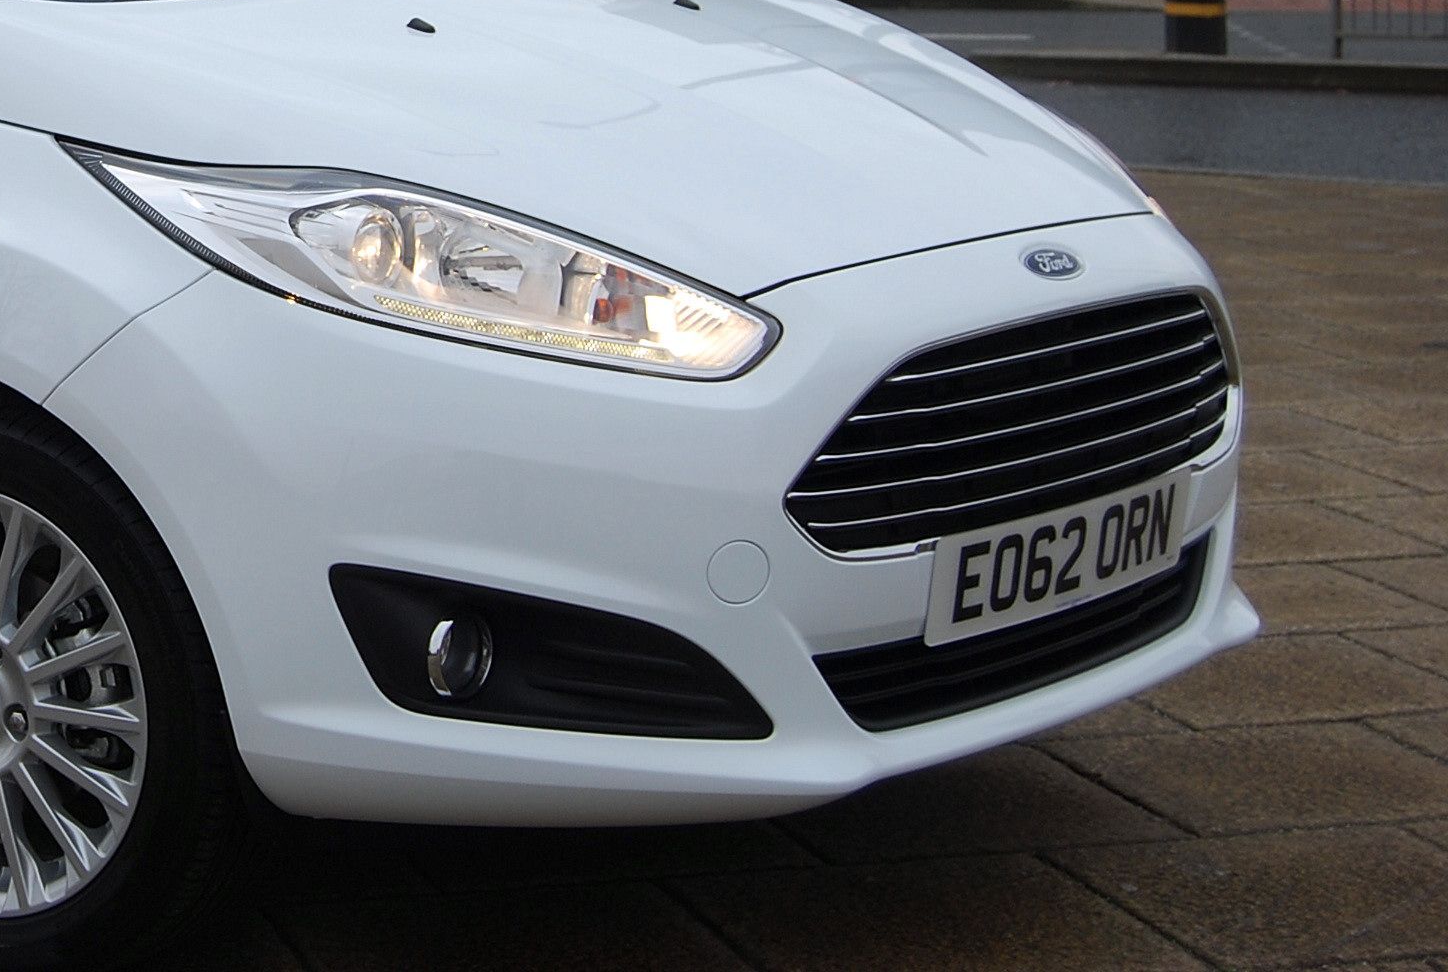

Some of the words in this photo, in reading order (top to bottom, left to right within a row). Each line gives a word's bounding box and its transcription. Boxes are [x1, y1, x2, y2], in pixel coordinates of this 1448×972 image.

[1034, 252, 1073, 273] Ford
[953, 516, 1087, 624] EO62
[1096, 483, 1175, 580] ORN
